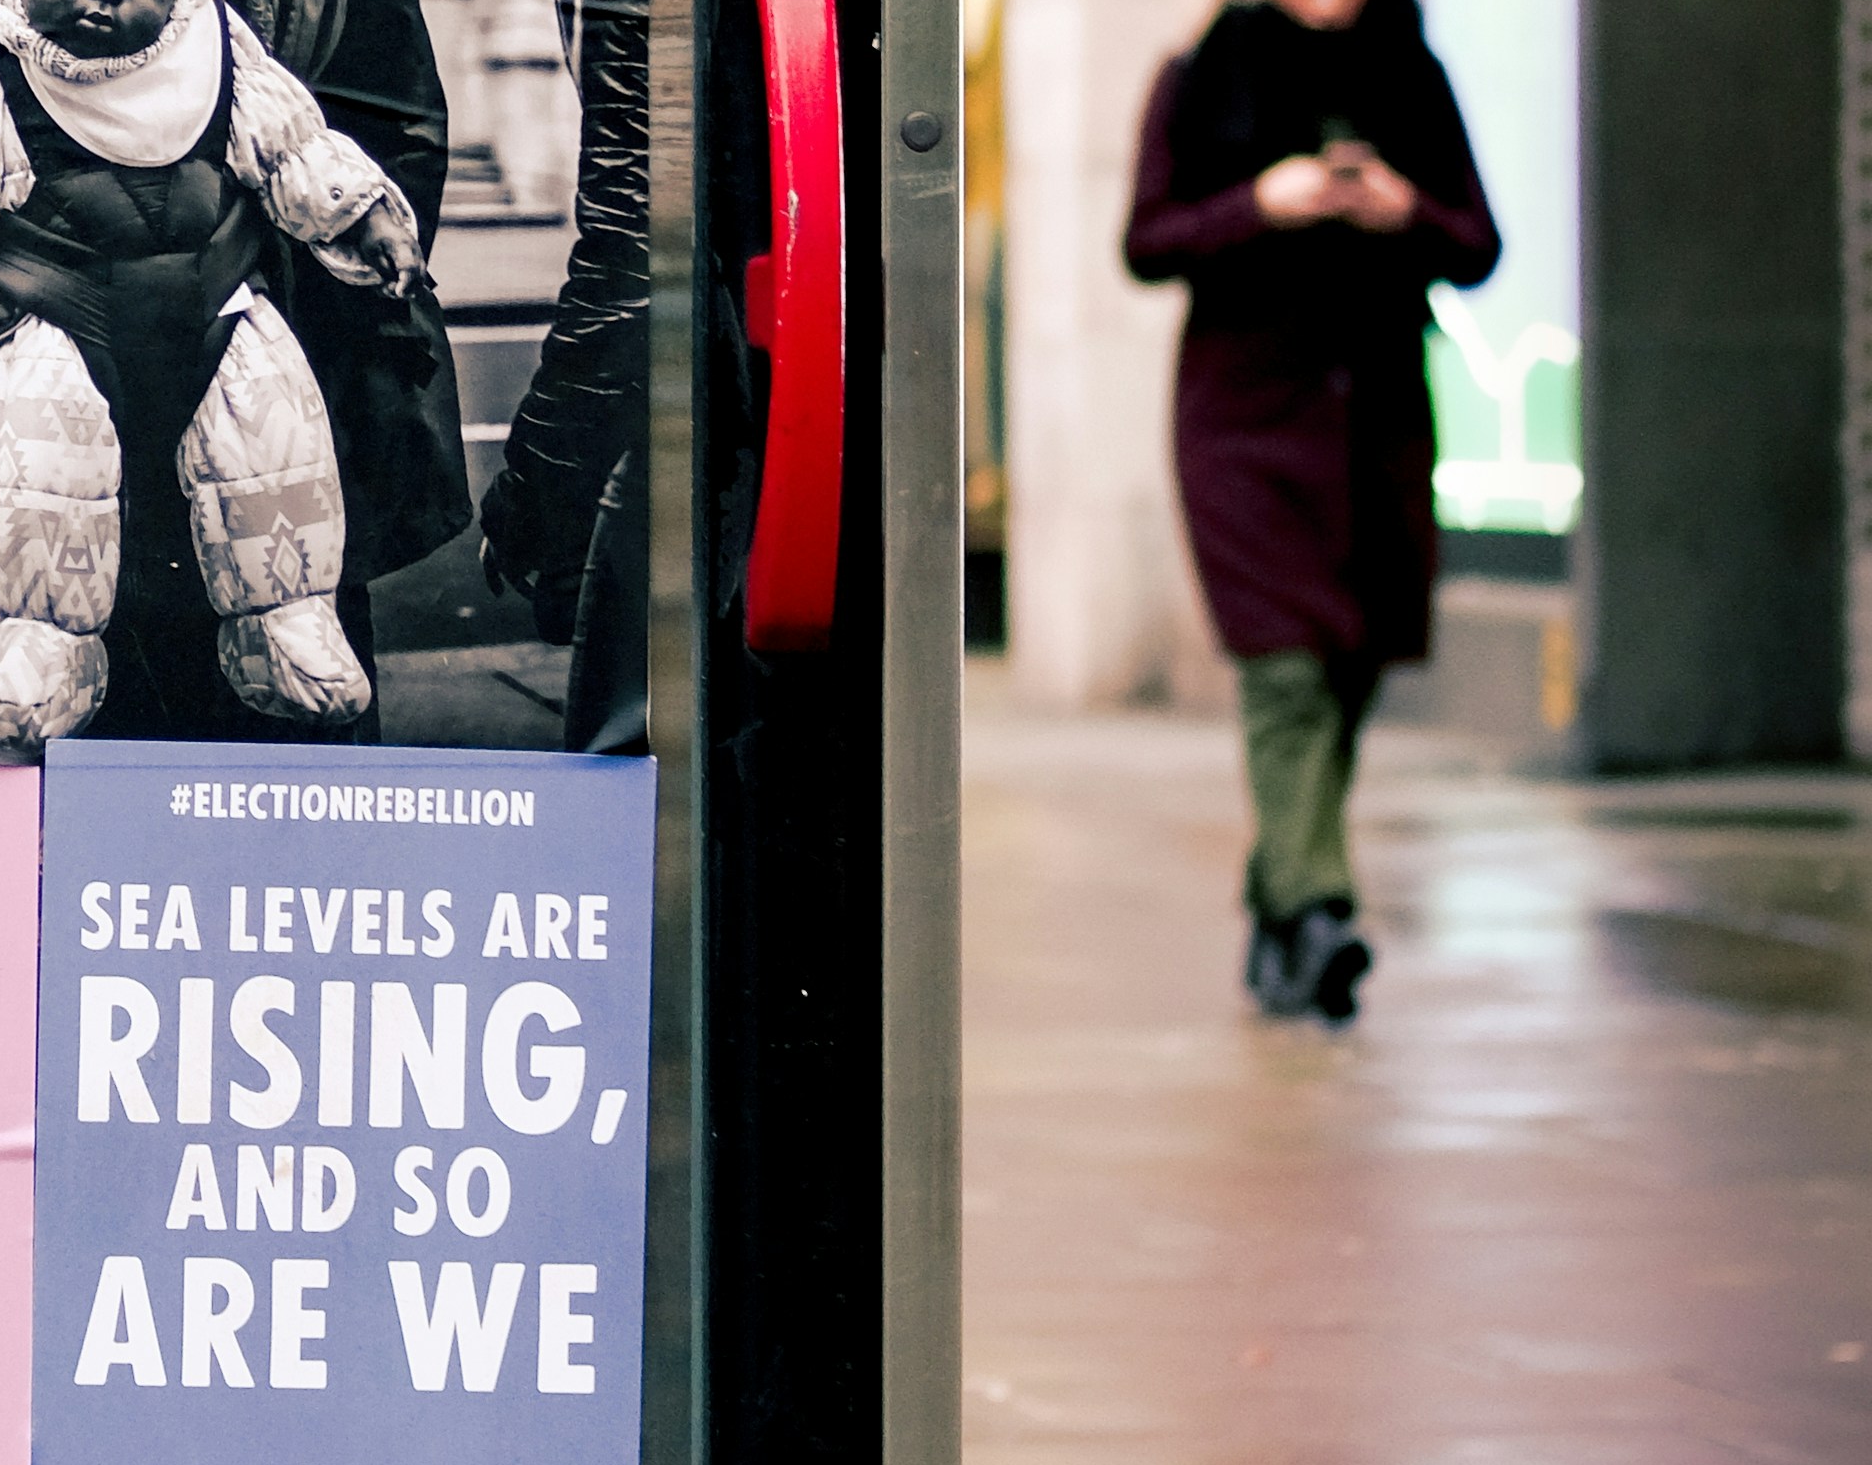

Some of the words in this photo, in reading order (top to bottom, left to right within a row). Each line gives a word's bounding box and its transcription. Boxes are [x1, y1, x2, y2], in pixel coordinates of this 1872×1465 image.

[169, 782, 535, 827] #ELECTIONREBELLION
[79, 880, 202, 952] SEA
[228, 885, 456, 959] LEVELS
[480, 892, 610, 961] ARE
[76, 973, 629, 1146] RISING,
[164, 1142, 358, 1233] AND
[392, 1144, 512, 1238] SO
[73, 1254, 330, 1390] ARE
[386, 1259, 599, 1395] WE
